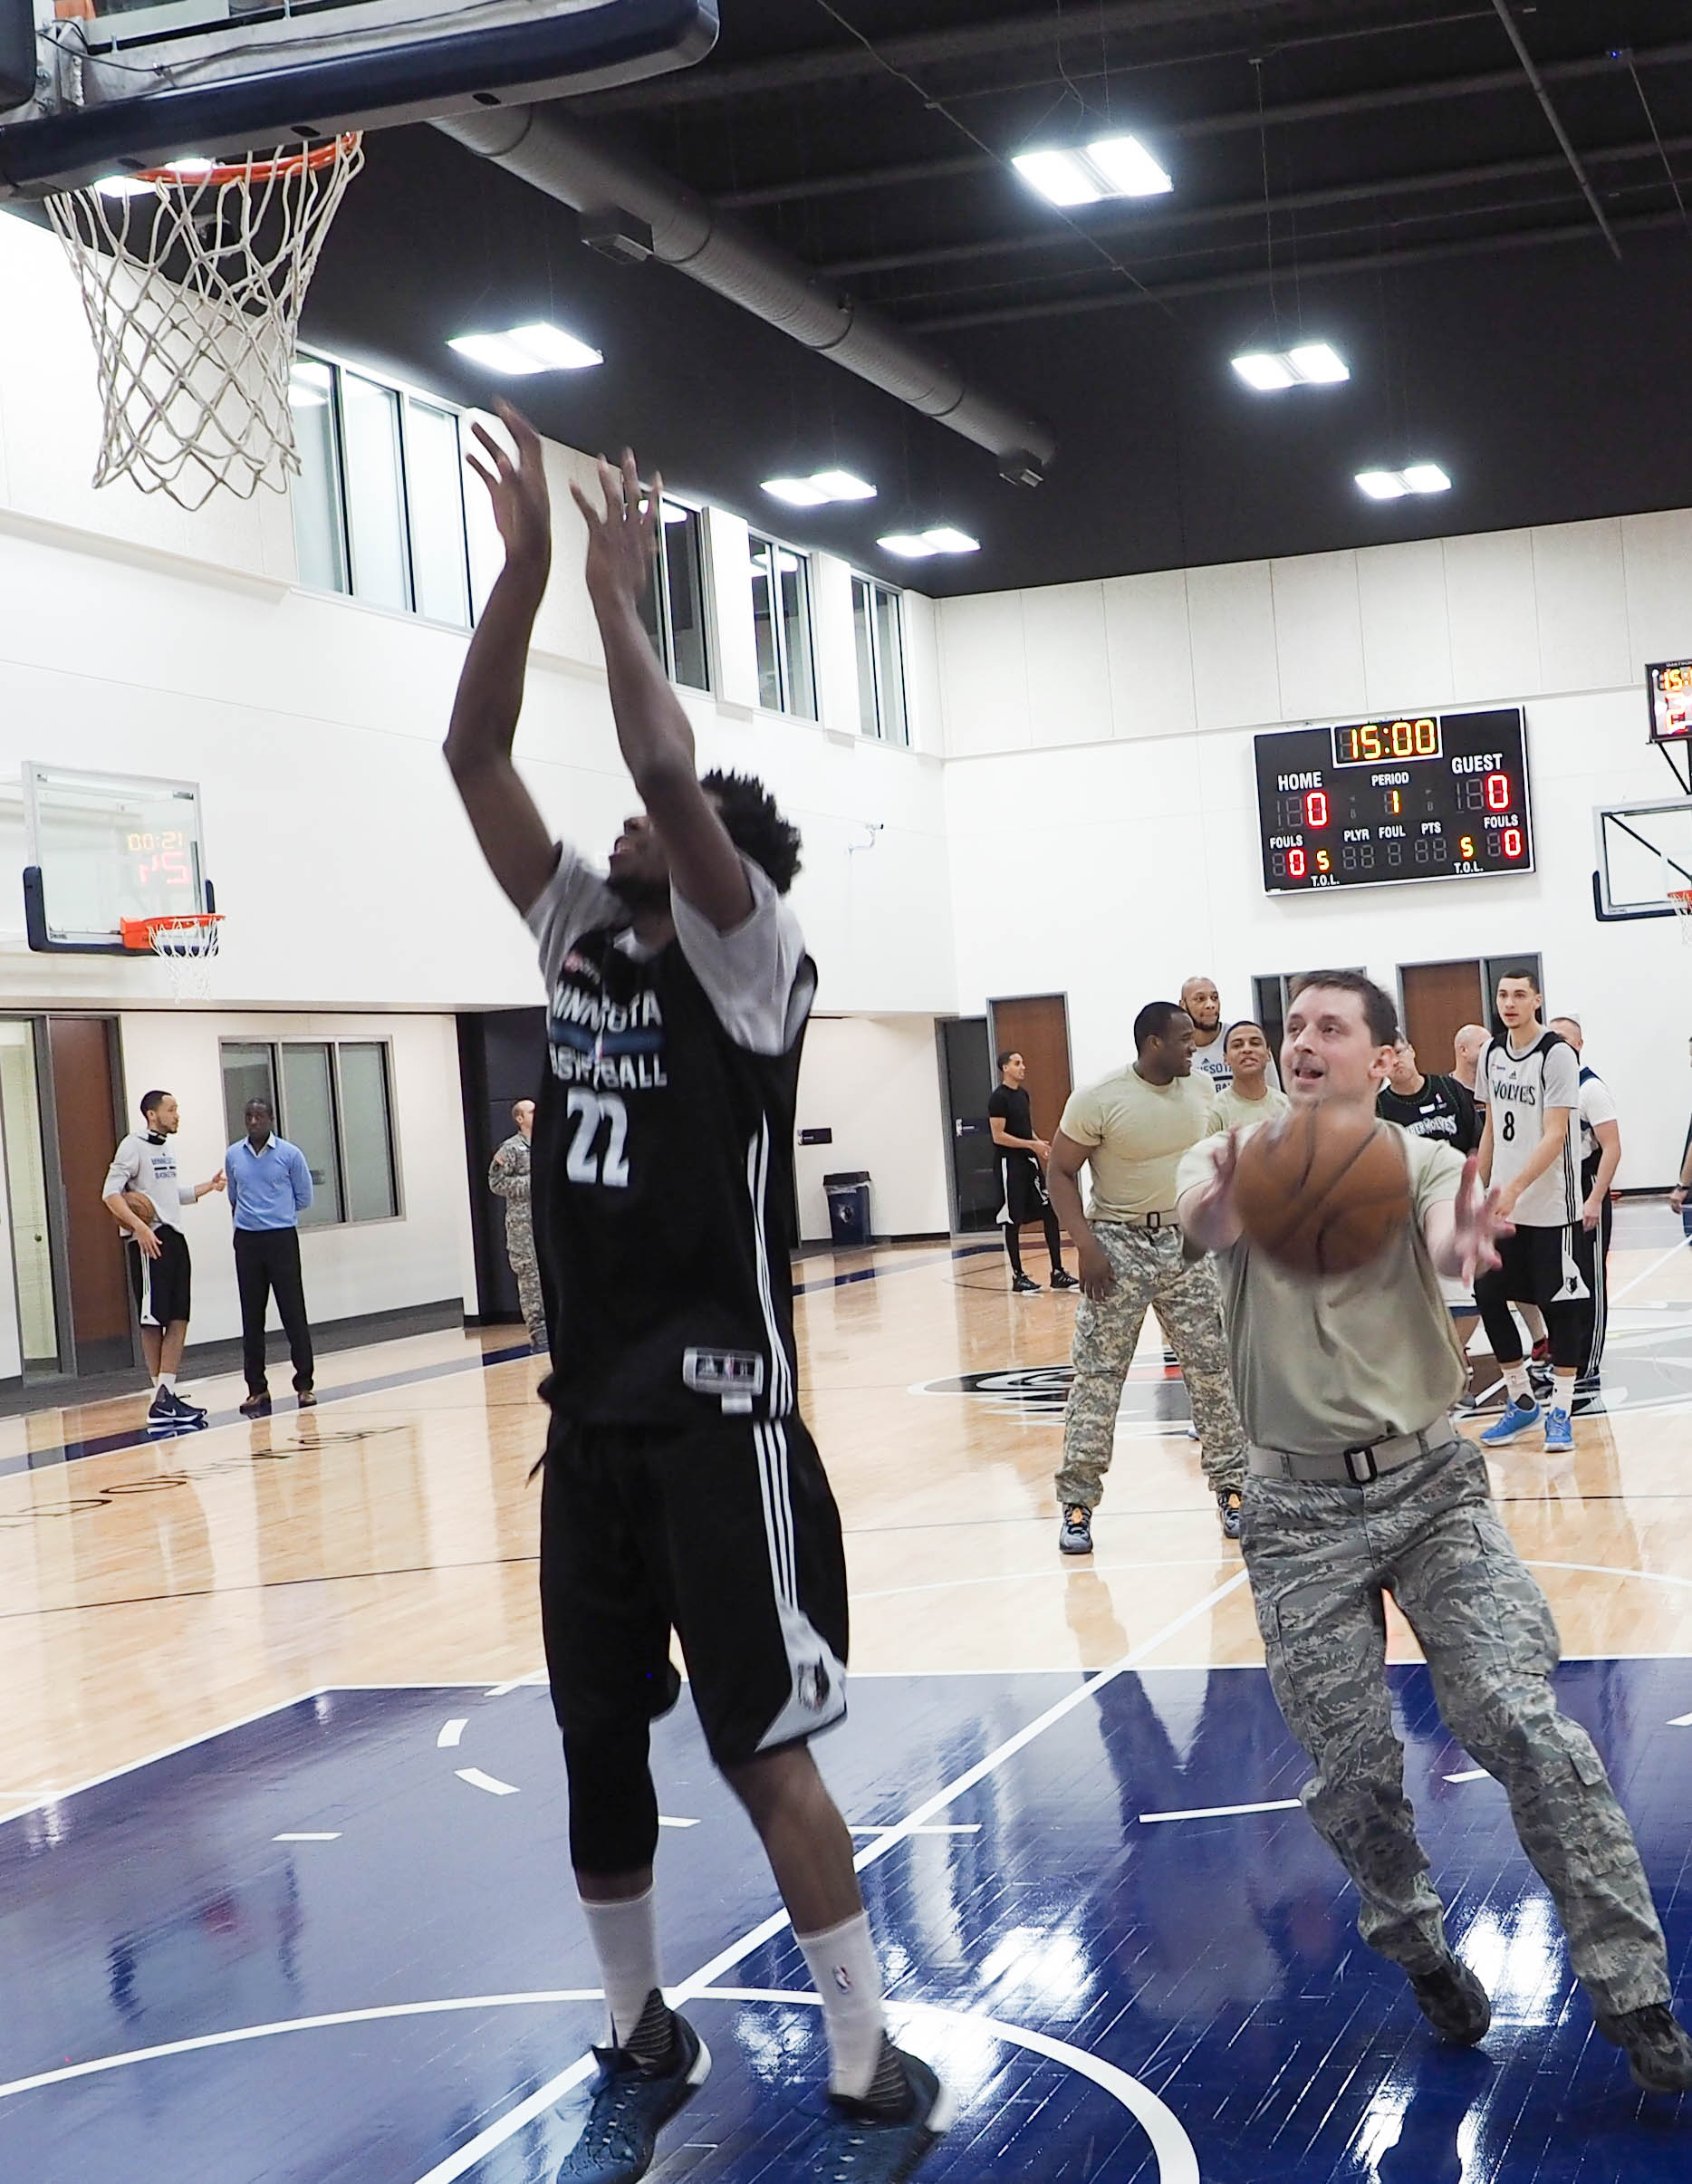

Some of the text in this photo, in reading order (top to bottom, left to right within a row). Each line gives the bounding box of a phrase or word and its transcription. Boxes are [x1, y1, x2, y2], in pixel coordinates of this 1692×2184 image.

[1351, 719, 1436, 760] 15:00
[1451, 754, 1503, 775] GUEST
[1278, 772, 1322, 791] HOME
[1371, 772, 1409, 787] PERIOD
[1487, 775, 1509, 809] 0
[1306, 792, 1327, 827] 0
[1420, 822, 1441, 835] PTS
[1484, 814, 1519, 830] FOULS
[1270, 834, 1303, 849] FOULS
[1343, 828, 1370, 842] PLYR
[1379, 825, 1406, 840] FOUL
[1503, 828, 1522, 857] 0
[1287, 849, 1306, 877] 0
[1454, 861, 1484, 874] T.O.L.
[1310, 876, 1340, 888] T.O.L.
[1503, 1111, 1515, 1141] 8
[566, 1088, 630, 1188] 22
